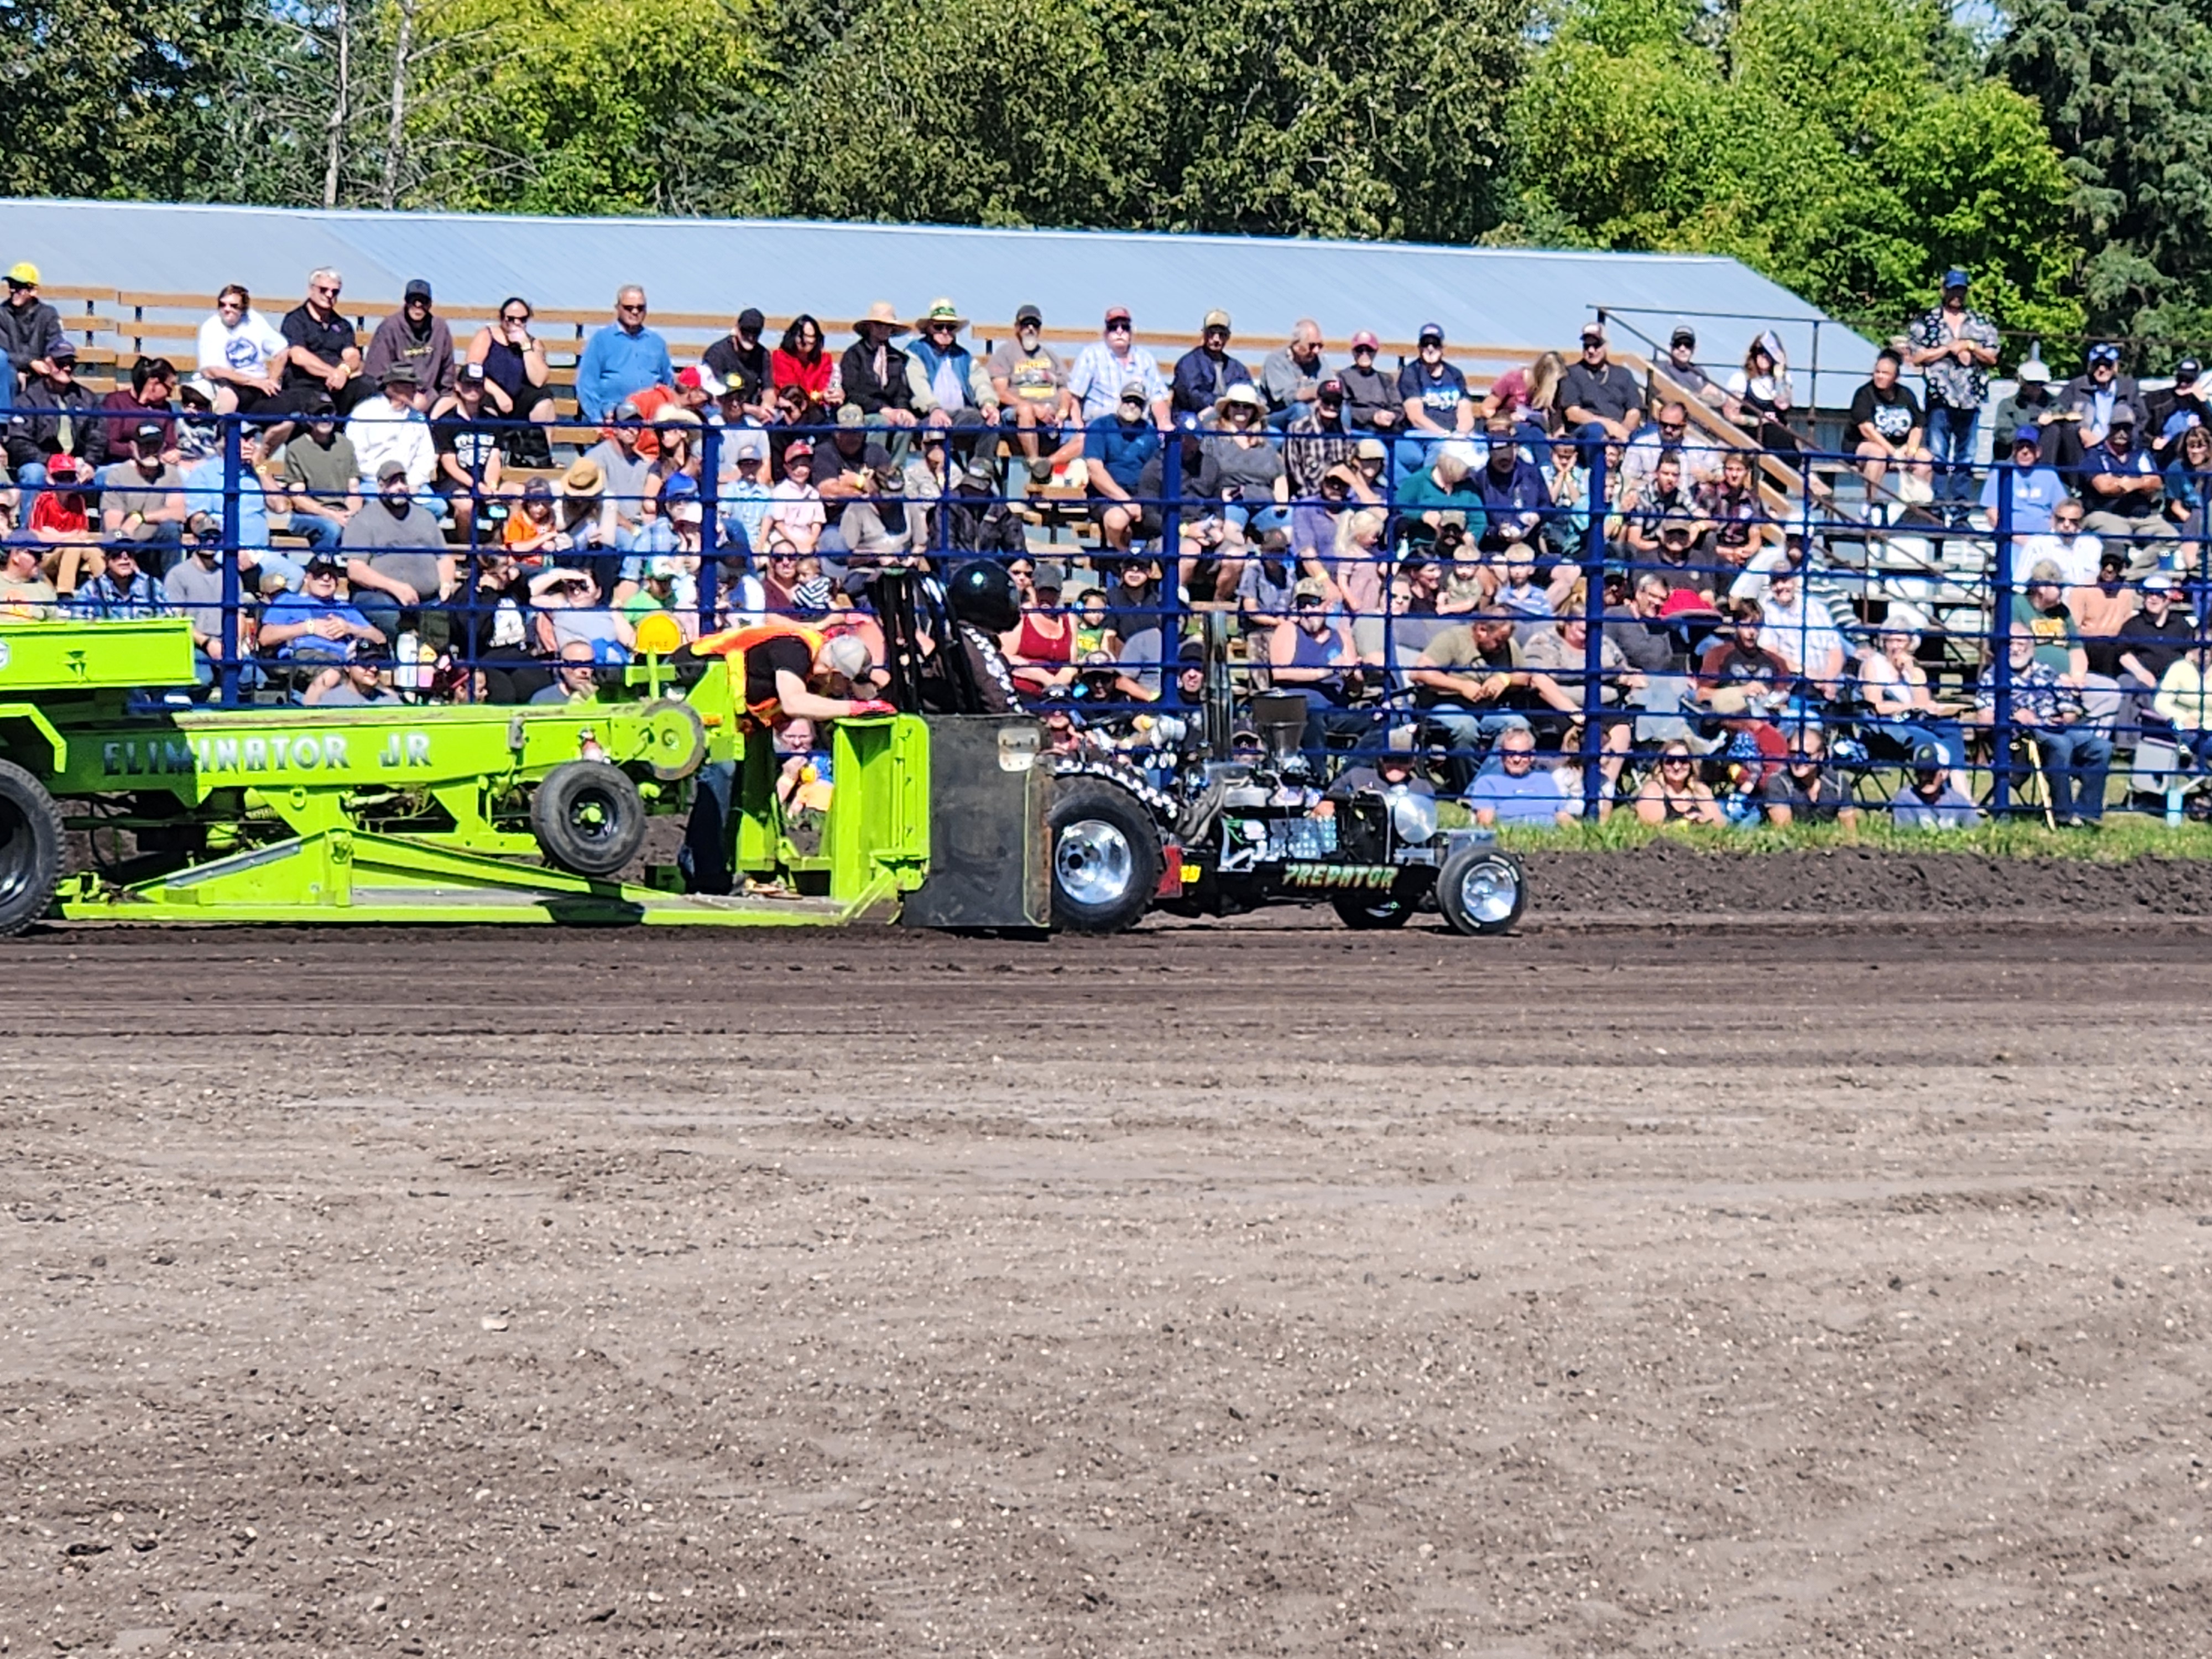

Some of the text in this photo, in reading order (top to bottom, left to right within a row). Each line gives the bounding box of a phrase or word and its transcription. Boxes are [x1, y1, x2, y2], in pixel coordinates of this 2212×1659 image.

[103, 733, 432, 775] ELIMINATOR JR
[1282, 864, 1399, 888] PREDATOR
